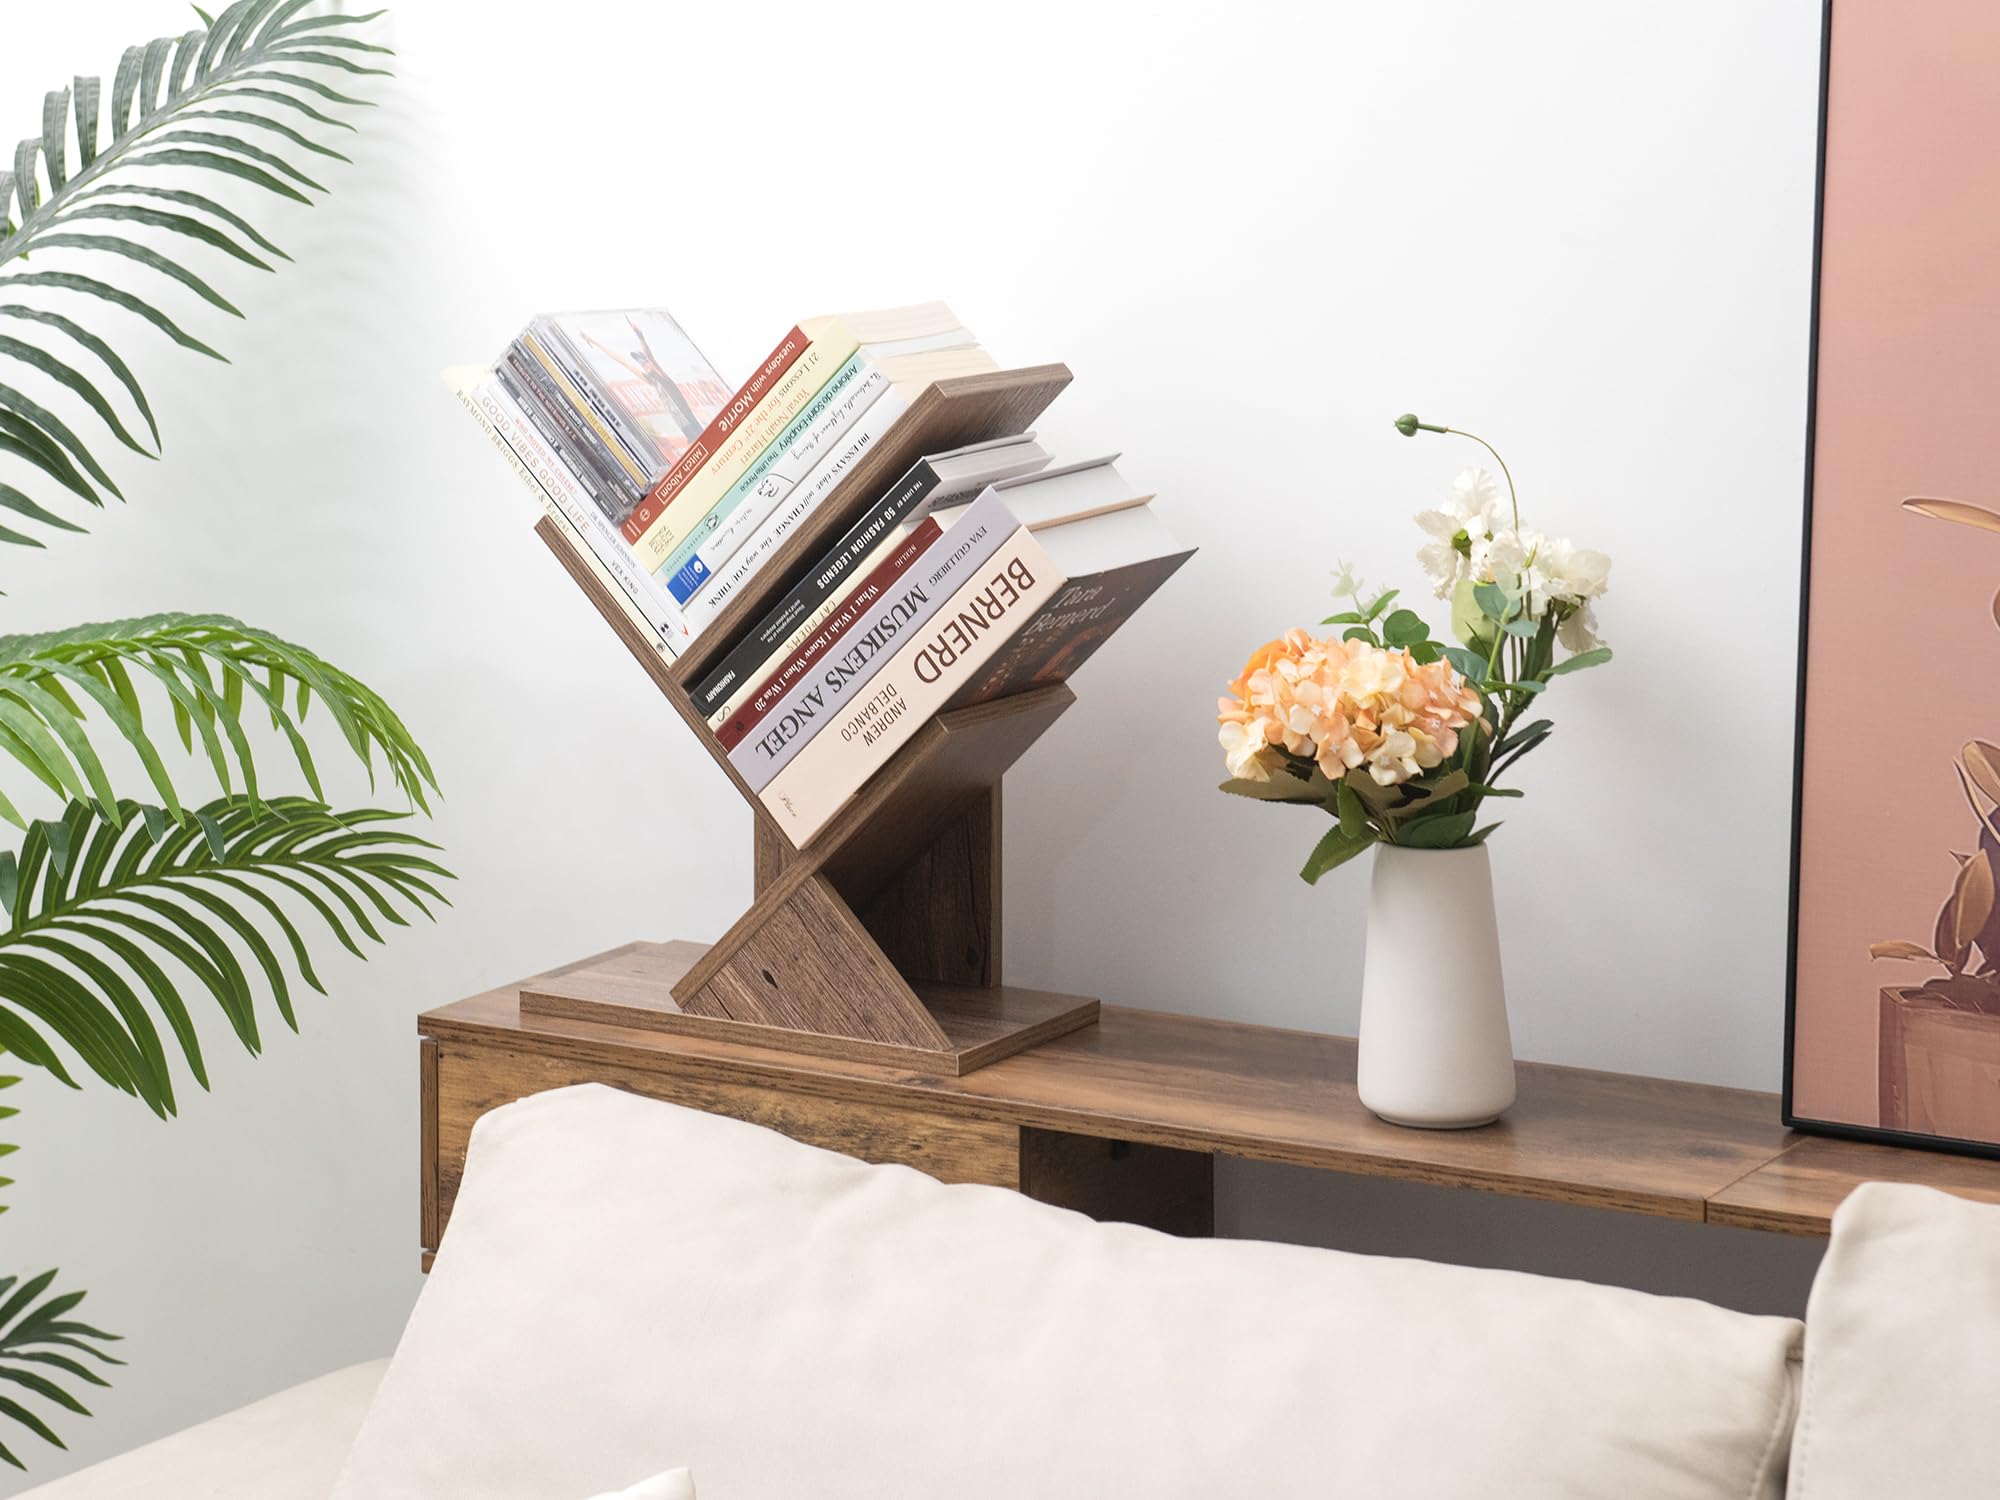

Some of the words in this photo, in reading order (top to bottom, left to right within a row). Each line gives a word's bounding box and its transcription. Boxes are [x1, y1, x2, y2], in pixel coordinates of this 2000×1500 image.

[764, 340, 796, 376] tuesdays
[807, 352, 820, 365] 21
[530, 381, 538, 390] TO
[750, 373, 768, 394] with
[778, 363, 810, 398] Lessons
[831, 364, 859, 395] Antoine
[870, 371, 881, 382] The
[766, 396, 782, 411] for
[786, 388, 810, 414] Yuval
[821, 390, 834, 406] de
[717, 391, 756, 434] Morrie
[753, 408, 771, 427] the
[765, 411, 790, 438] Noah
[776, 401, 825, 452] Saint-Exupéry
[514, 418, 529, 434] WHO
[527, 434, 547, 457] MOVED
[546, 457, 556, 468] MY
[740, 434, 769, 466] Harari
[857, 433, 870, 447] 101
[455, 390, 493, 435] RAYMOND
[490, 434, 521, 470] BRIGGS
[517, 468, 541, 496] Ethel
[537, 493, 547, 503] &
[545, 503, 571, 534] Ernest
[481, 397, 511, 432] GOOD
[509, 432, 541, 469] VIBES
[538, 468, 569, 505] GOOD
[567, 505, 591, 533] LIFE
[682, 448, 704, 473] Mitch
[709, 439, 744, 476] Century
[755, 460, 770, 476] Little
[766, 450, 779, 463] The
[831, 444, 859, 475] ESSAYS
[660, 470, 685, 498] Albom
[739, 472, 758, 492] Prince
[816, 472, 832, 491] that
[802, 490, 816, 506] will
[896, 499, 903, 507] OF
[902, 488, 914, 501] LIVES
[773, 502, 805, 537] CHANGE
[884, 506, 896, 520] 50
[597, 521, 618, 545] SPENCER
[615, 544, 637, 568] JOHNSON
[759, 536, 773, 551] the
[850, 517, 885, 554] FASHION
[970, 525, 987, 546] EVA
[744, 550, 759, 566] way
[894, 544, 917, 569] SEELIG
[929, 542, 971, 587] GULLBERG
[610, 560, 625, 576] VEX
[623, 576, 639, 595] KING
[730, 564, 748, 584] YOU
[816, 551, 852, 589] LEGENDS
[707, 581, 733, 608] THINK
[855, 583, 879, 607] What
[1051, 586, 1103, 609] Tara
[817, 599, 837, 621] CAT
[849, 605, 857, 614] I
[912, 558, 1037, 684] BERNERD
[1022, 597, 1116, 636] Bernerd
[829, 611, 852, 635] Wish
[785, 618, 818, 653] POEMS
[823, 631, 832, 641] I
[823, 582, 930, 695] MUSIKENS
[803, 636, 827, 660] Knew
[783, 657, 807, 681] When
[704, 669, 736, 703] FASHIONARY
[763, 682, 782, 701] Was
[778, 677, 786, 687] I
[754, 697, 767, 712] 20
[839, 683, 898, 743] DELBANCO
[755, 683, 831, 763] ANGEL
[861, 697, 909, 747] ANDREW
